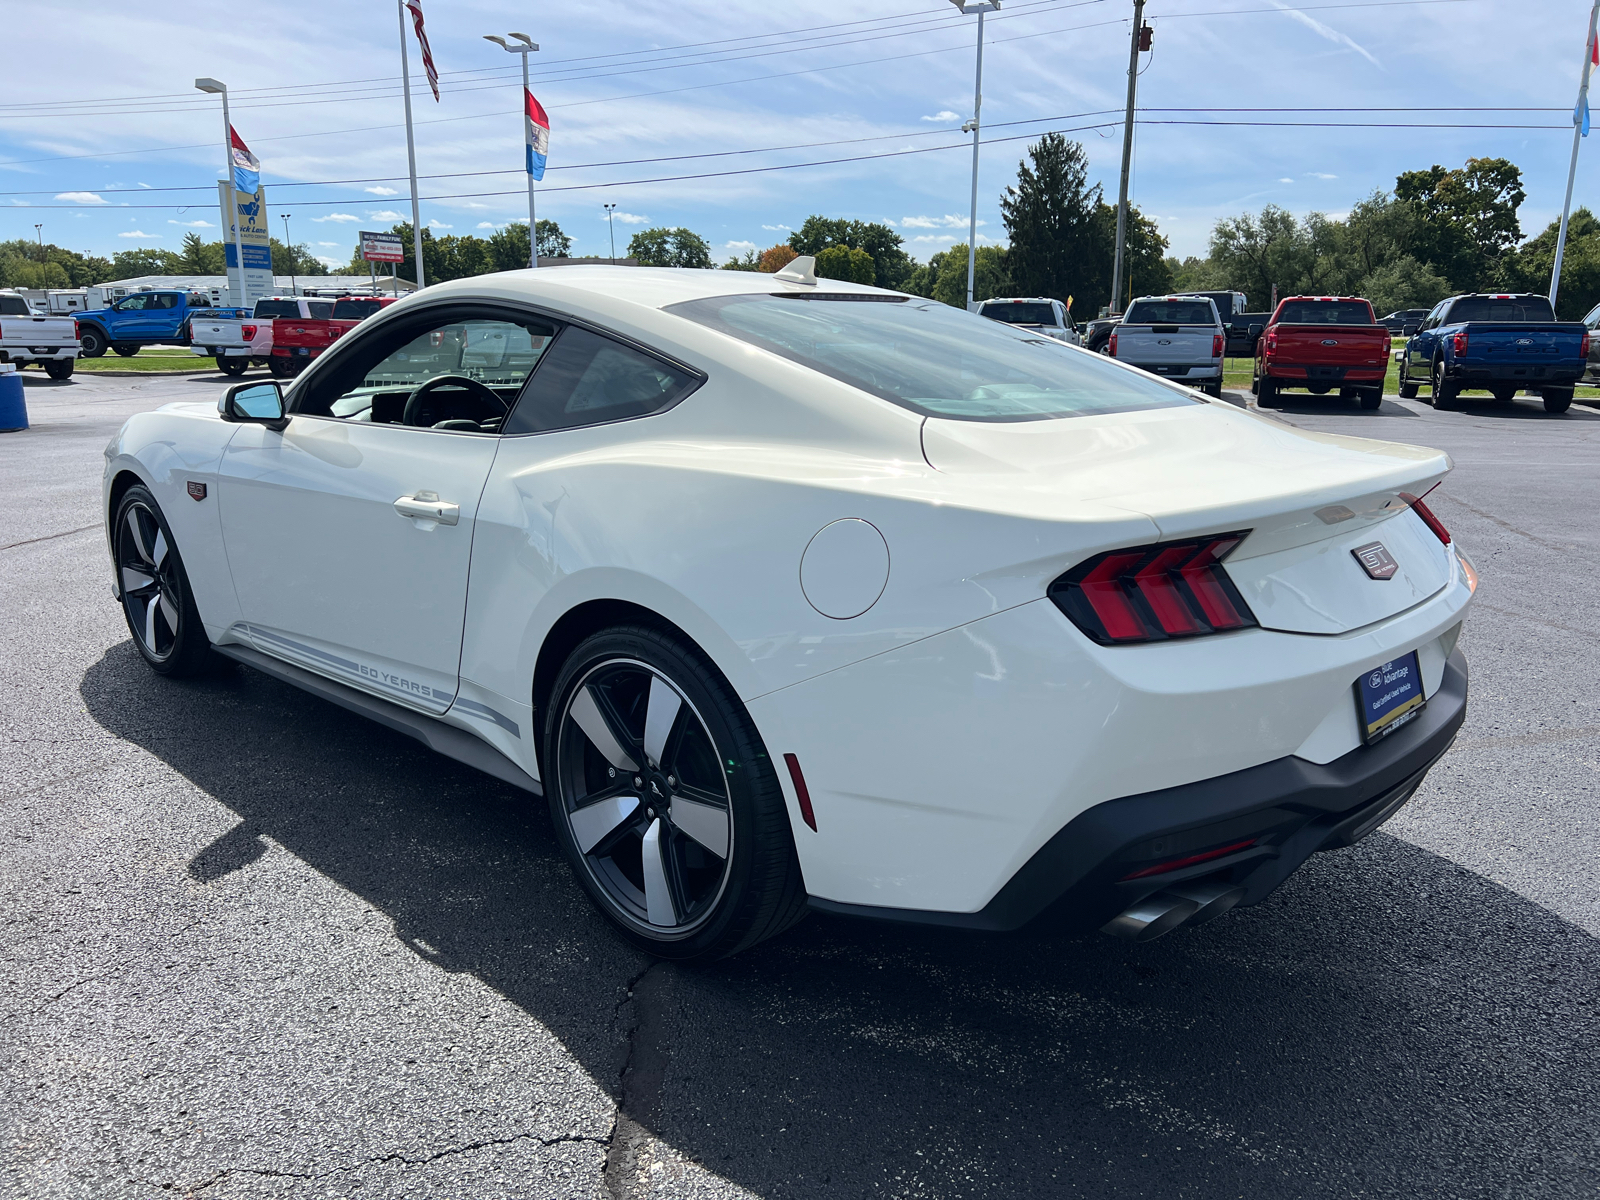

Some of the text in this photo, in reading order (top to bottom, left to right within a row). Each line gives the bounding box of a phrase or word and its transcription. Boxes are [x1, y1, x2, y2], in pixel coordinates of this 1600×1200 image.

[231, 224, 266, 235] Qick Lane
[1359, 545, 1387, 569] GT
[1382, 662, 1393, 674] Blue
[1384, 666, 1409, 685] Advantage
[360, 665, 431, 697] 60 YEARS
